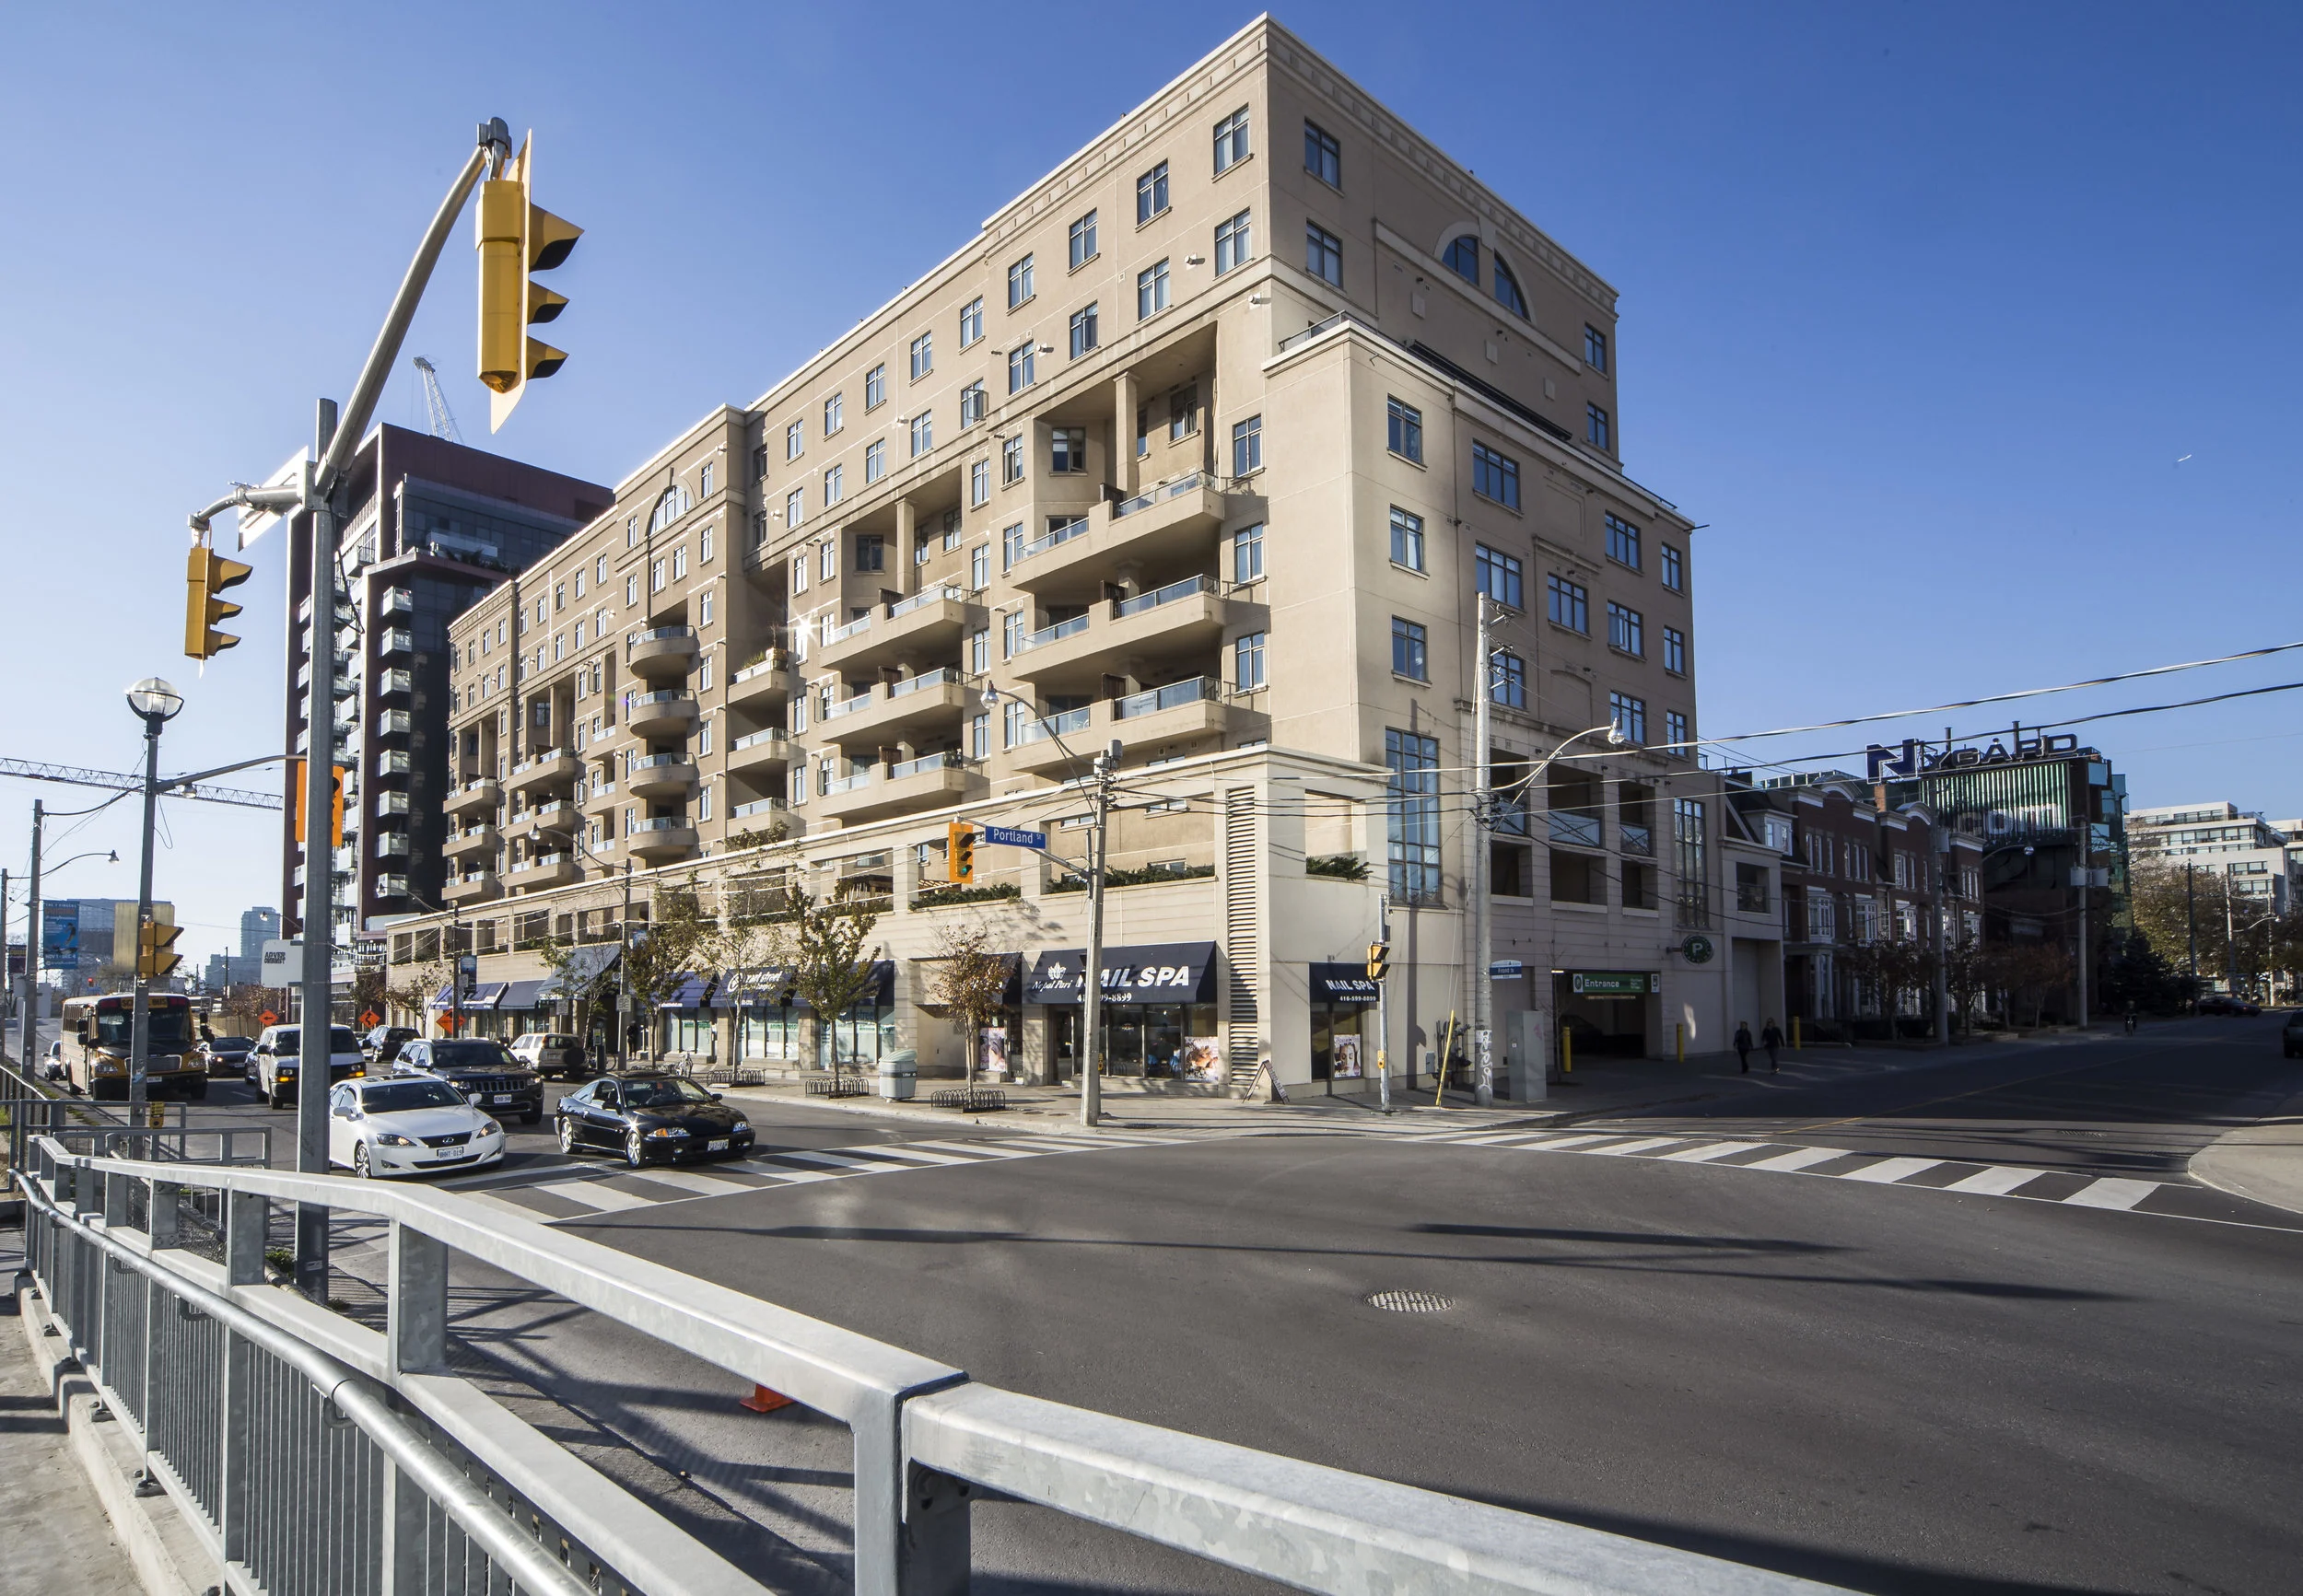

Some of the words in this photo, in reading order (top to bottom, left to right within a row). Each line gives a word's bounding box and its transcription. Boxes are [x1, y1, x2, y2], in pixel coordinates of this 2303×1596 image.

[993, 828, 1034, 844] Portland
[1691, 943, 1704, 955] P
[1137, 966, 1189, 987] SPA
[1326, 980, 1353, 991] NAIL
[1352, 980, 1375, 991] SPA
[1584, 978, 1619, 988] Entrance
